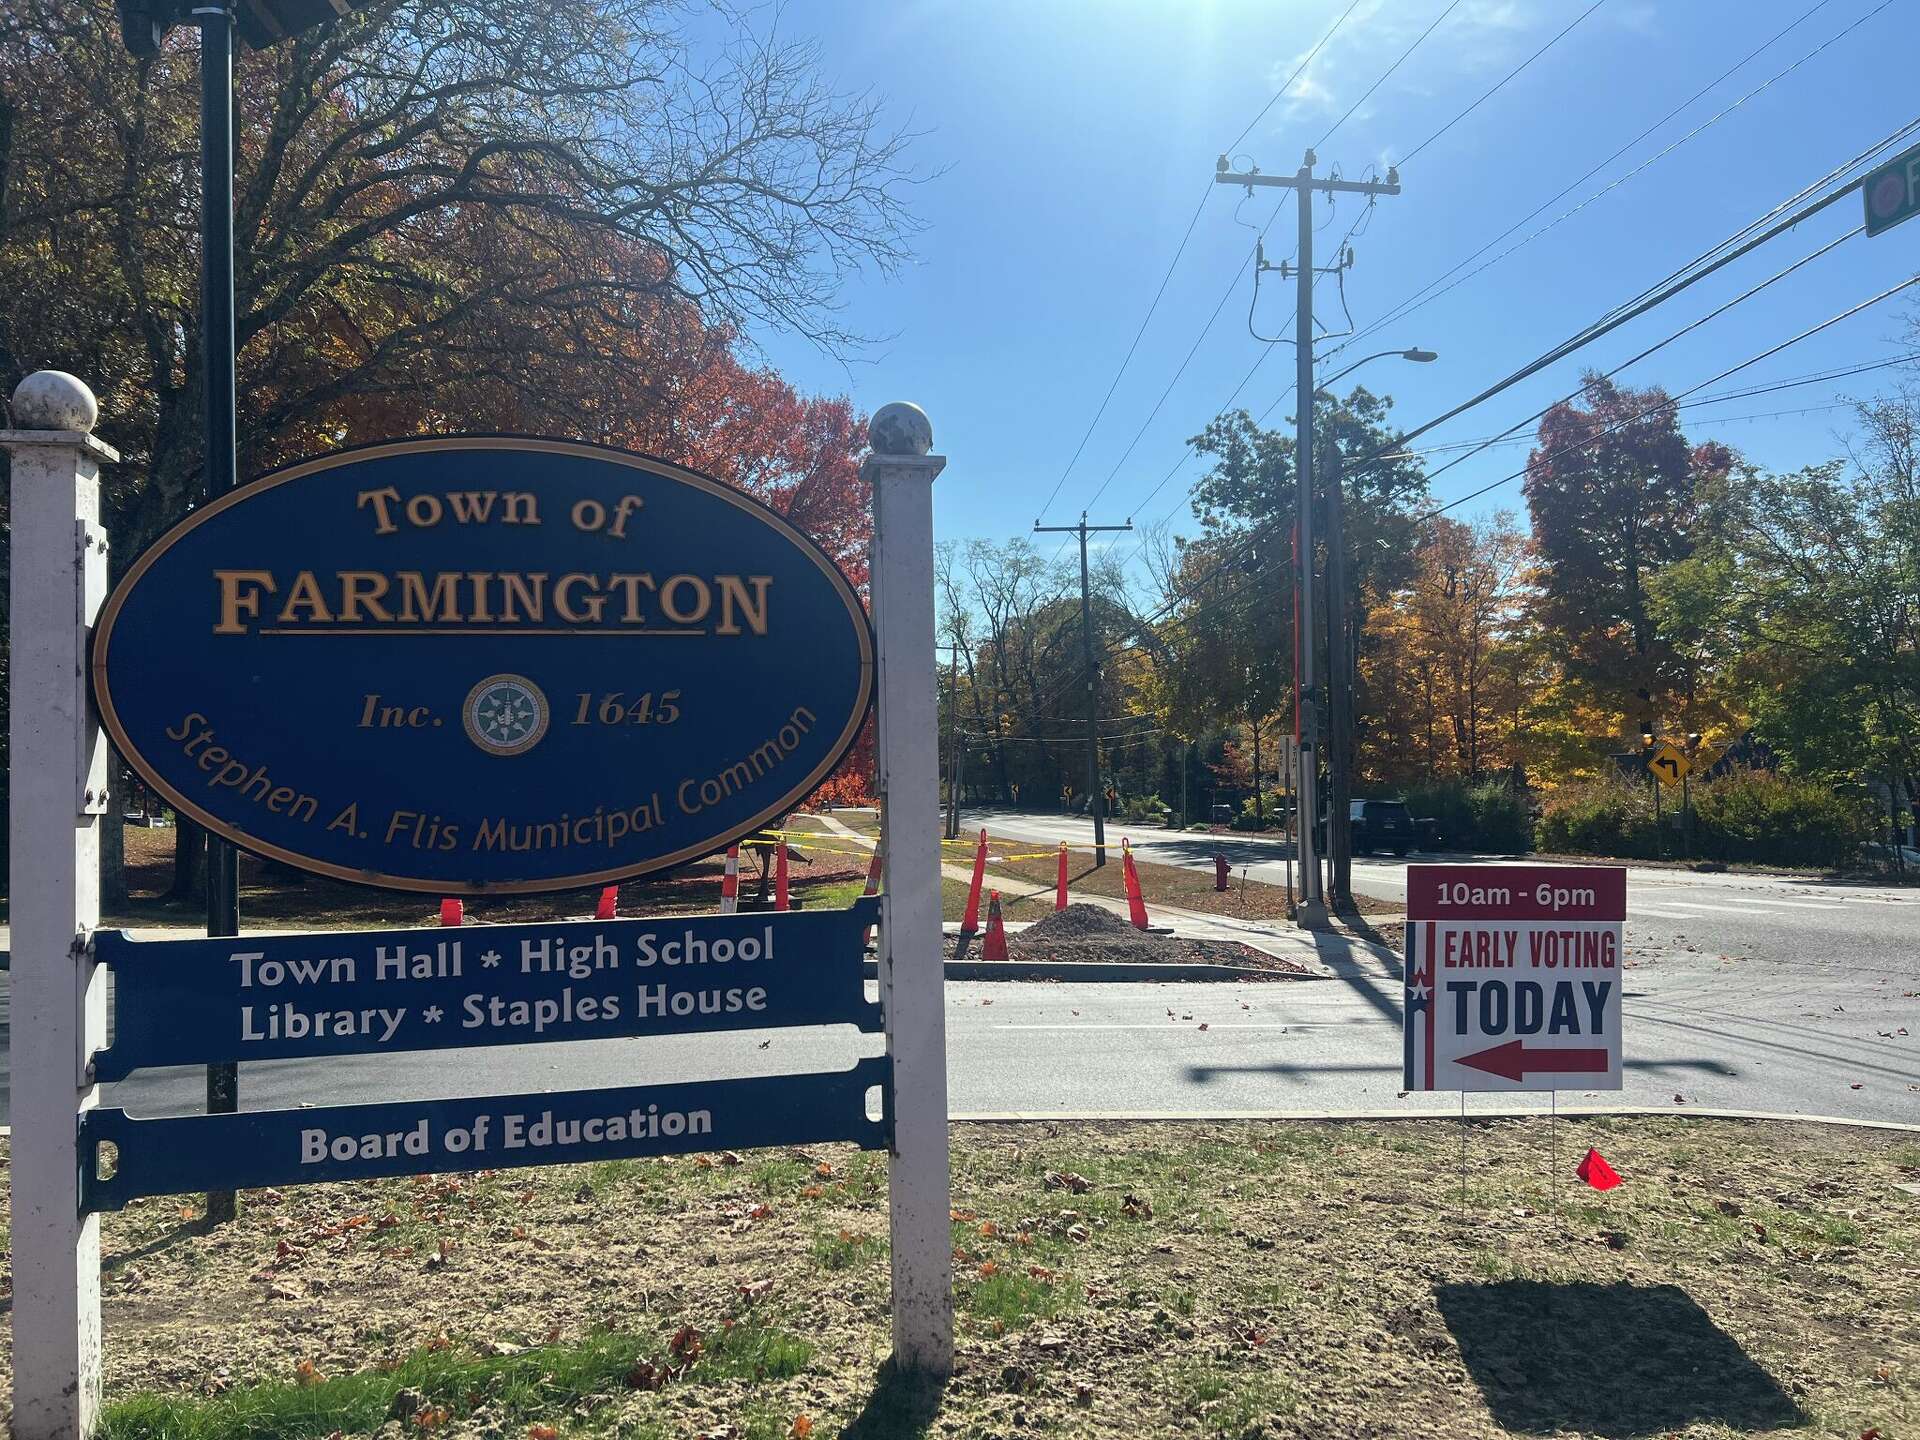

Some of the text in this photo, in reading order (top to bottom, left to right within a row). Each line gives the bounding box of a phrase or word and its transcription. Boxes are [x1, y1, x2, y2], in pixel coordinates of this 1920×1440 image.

[356, 486, 643, 538] Town of
[213, 569, 773, 636] FARMINGTON
[356, 694, 443, 728] Inc.
[569, 689, 681, 726] 1645
[166, 704, 816, 852] Stephen A. Flis Municipal Common
[1436, 882, 1511, 906] 10am
[1535, 883, 1596, 911] 6pm
[228, 926, 774, 988] Town Hall High School
[1444, 930, 1616, 969] EARLY VOTING
[240, 983, 768, 1042] Library Staples House
[1446, 979, 1612, 1036] TODAY
[300, 1103, 713, 1164] Board of Education
